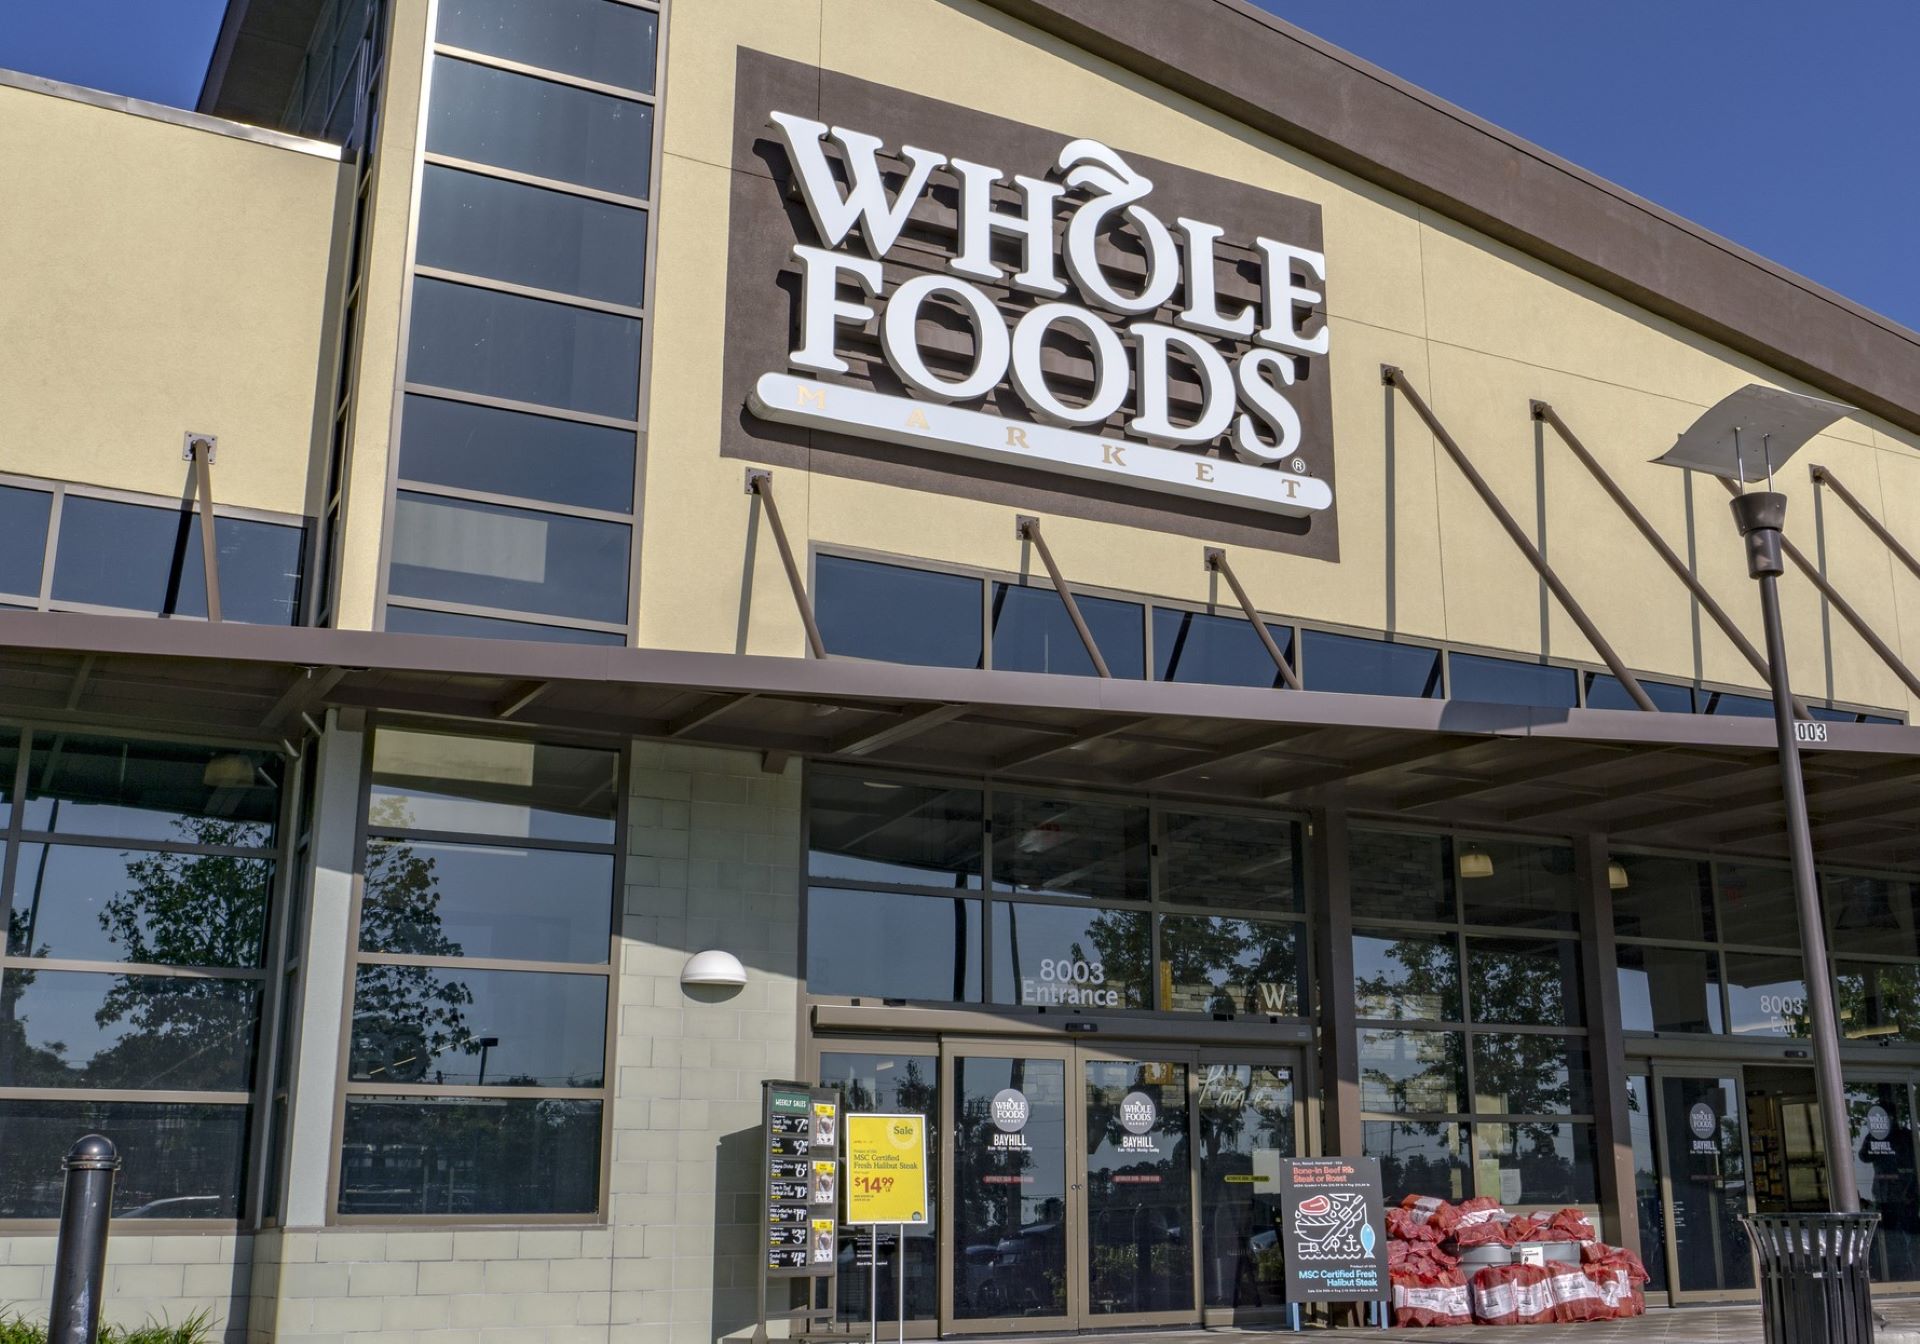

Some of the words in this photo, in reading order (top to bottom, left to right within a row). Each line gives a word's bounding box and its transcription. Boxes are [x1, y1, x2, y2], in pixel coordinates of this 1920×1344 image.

[770, 111, 1329, 357] WHOLE
[789, 245, 1302, 462] FOODS
[796, 384, 1301, 499] MARKET
[1796, 723, 1826, 741] 003
[1040, 958, 1105, 985] 8003
[1023, 980, 1119, 1006] Entrance
[1760, 995, 1804, 1016] 8003
[1770, 1016, 1797, 1033] Exit
[995, 1099, 1025, 1111] WHOLE
[1123, 1103, 1152, 1113] WHOLE
[997, 1111, 1025, 1119] FOODS
[1125, 1113, 1152, 1121] FOODS
[893, 1126, 914, 1135] Sale
[993, 1133, 1027, 1146] BAYHILL
[1122, 1135, 1154, 1148] BAYHILL
[899, 1162, 918, 1170] Steak
[1293, 1167, 1323, 1175] Bone-In
[1323, 1166, 1341, 1174] Beef
[1341, 1166, 1355, 1174] Rib
[1293, 1175, 1315, 1183] Steak
[1325, 1174, 1347, 1182] Roast
[1298, 1270, 1320, 1279] MSC
[1320, 1269, 1355, 1279] Certified
[1355, 1269, 1377, 1279] Fresh
[1327, 1279, 1355, 1287] Halibut
[1355, 1278, 1378, 1287] Steak
